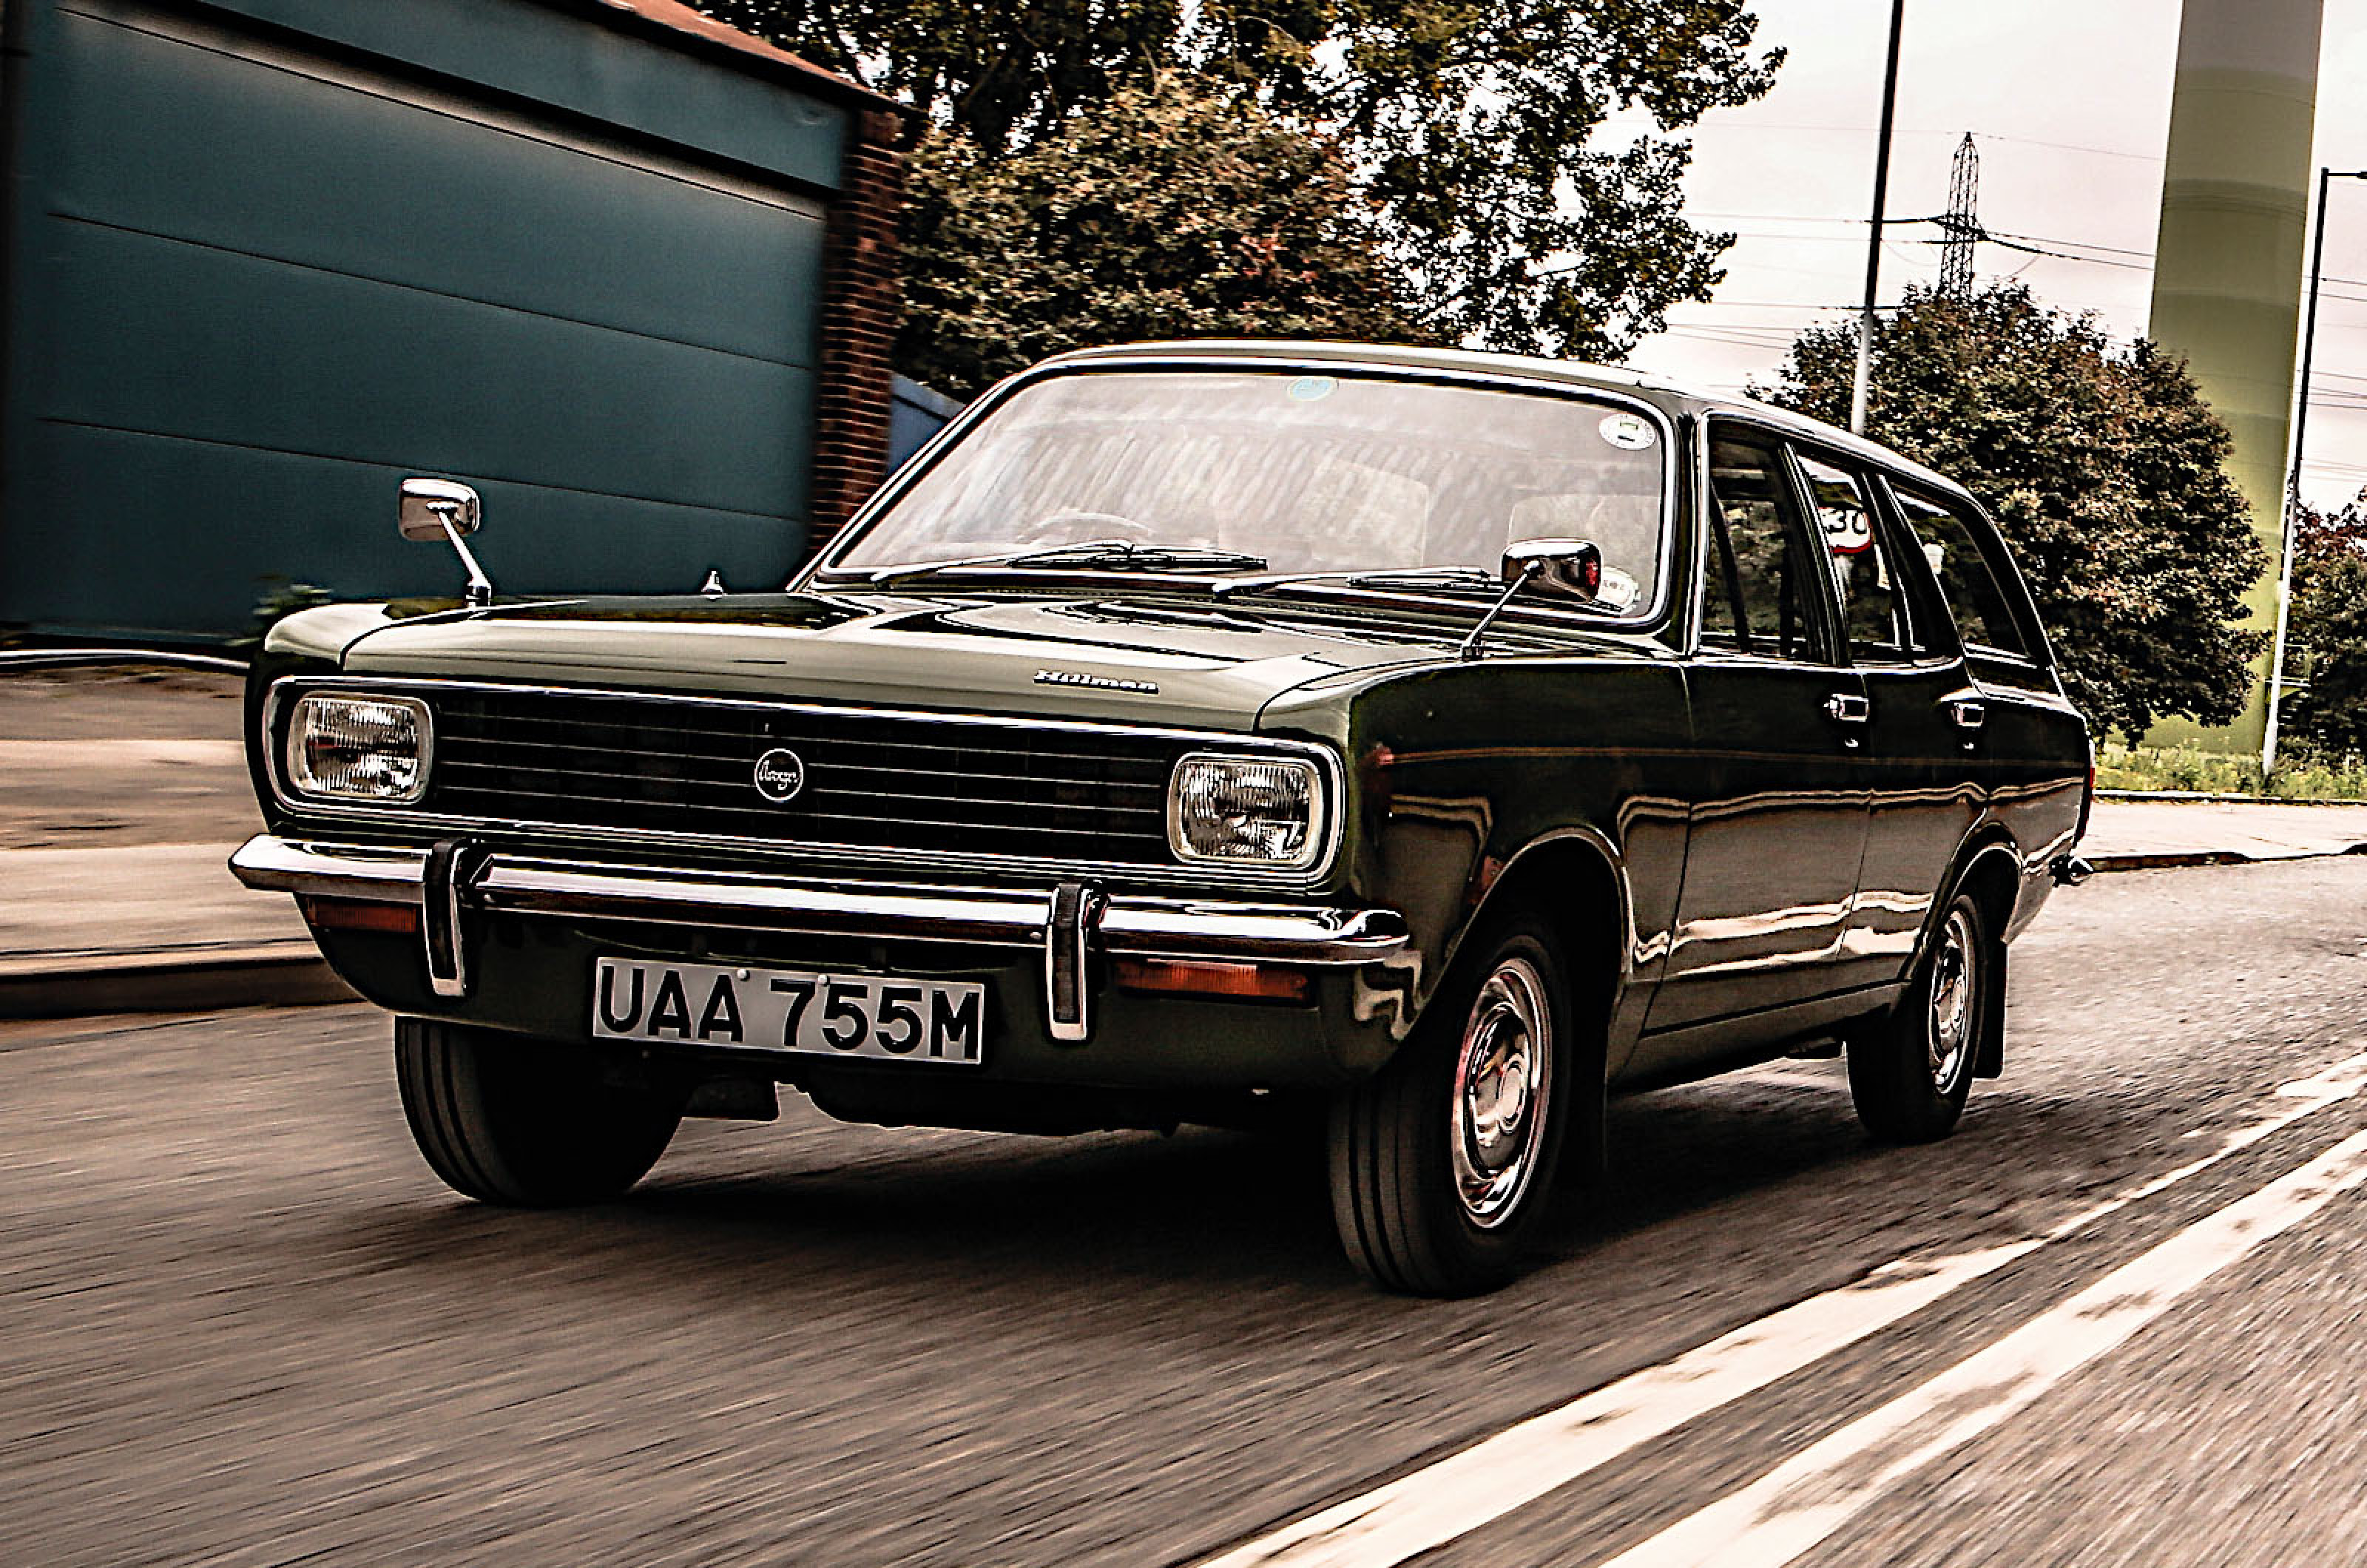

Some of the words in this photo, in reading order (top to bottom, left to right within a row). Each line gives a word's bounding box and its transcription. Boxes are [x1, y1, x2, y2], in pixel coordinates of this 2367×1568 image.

[1823, 508, 1867, 534] 30
[1033, 669, 1160, 694] Hillman
[599, 966, 743, 1042] UAA
[770, 979, 979, 1059] 755M
